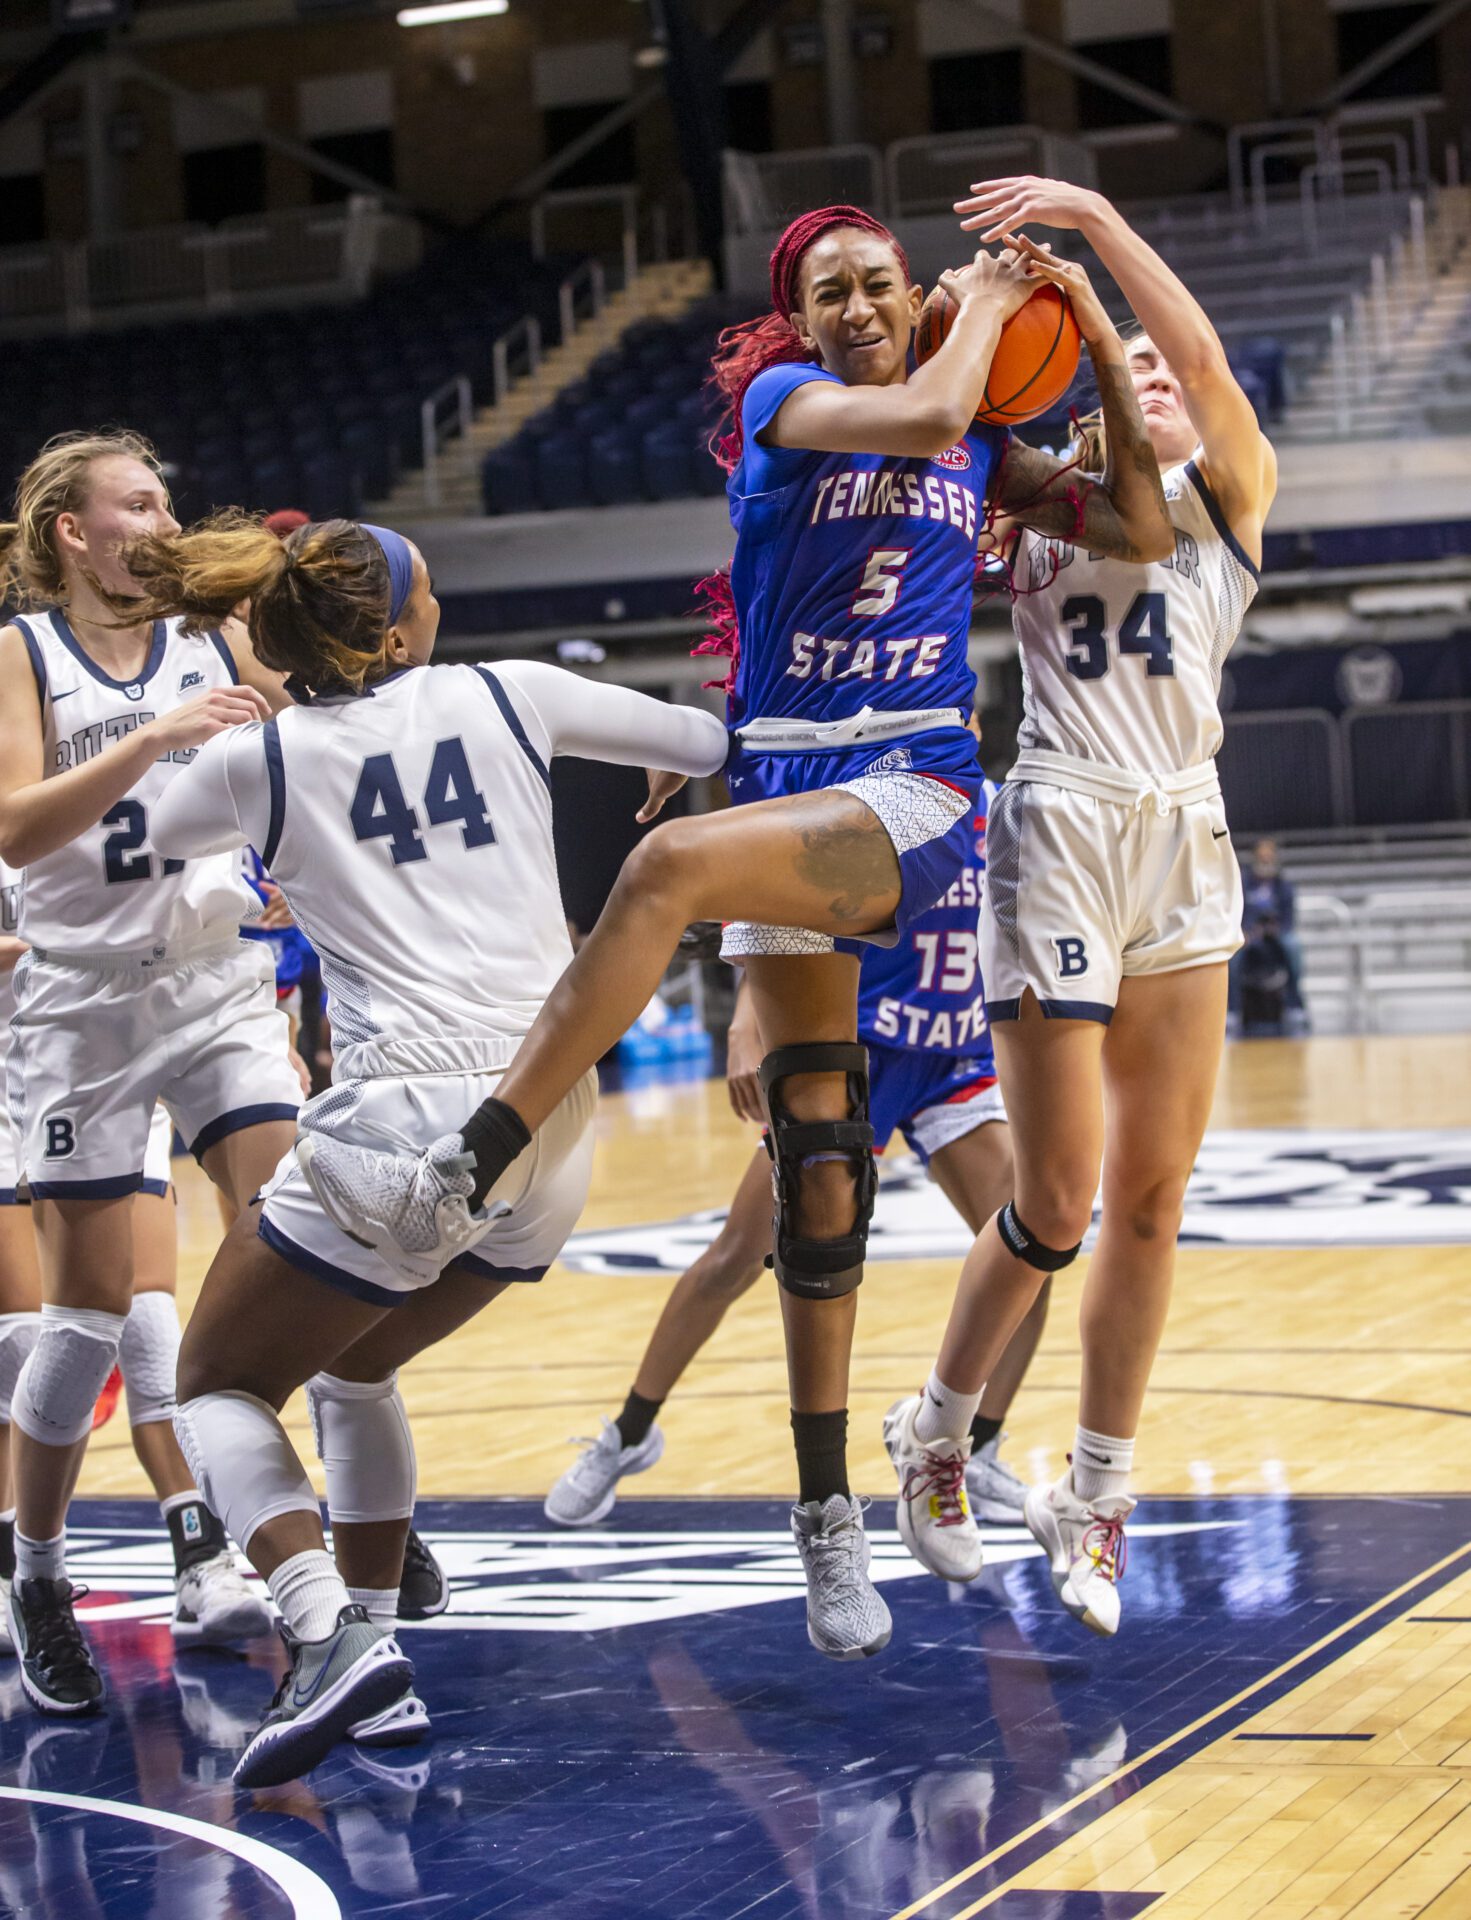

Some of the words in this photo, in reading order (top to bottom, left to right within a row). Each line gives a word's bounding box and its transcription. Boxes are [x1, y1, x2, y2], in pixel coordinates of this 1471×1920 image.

[810, 471, 976, 541] TENNESSEE
[850, 549, 911, 617] 5
[785, 631, 948, 681] STATE
[1060, 589, 1177, 682] 34
[347, 733, 499, 869] 44
[914, 931, 978, 993] 13
[1054, 937, 1090, 978] B
[873, 995, 987, 1049] STATE
[45, 1117, 75, 1158] B
